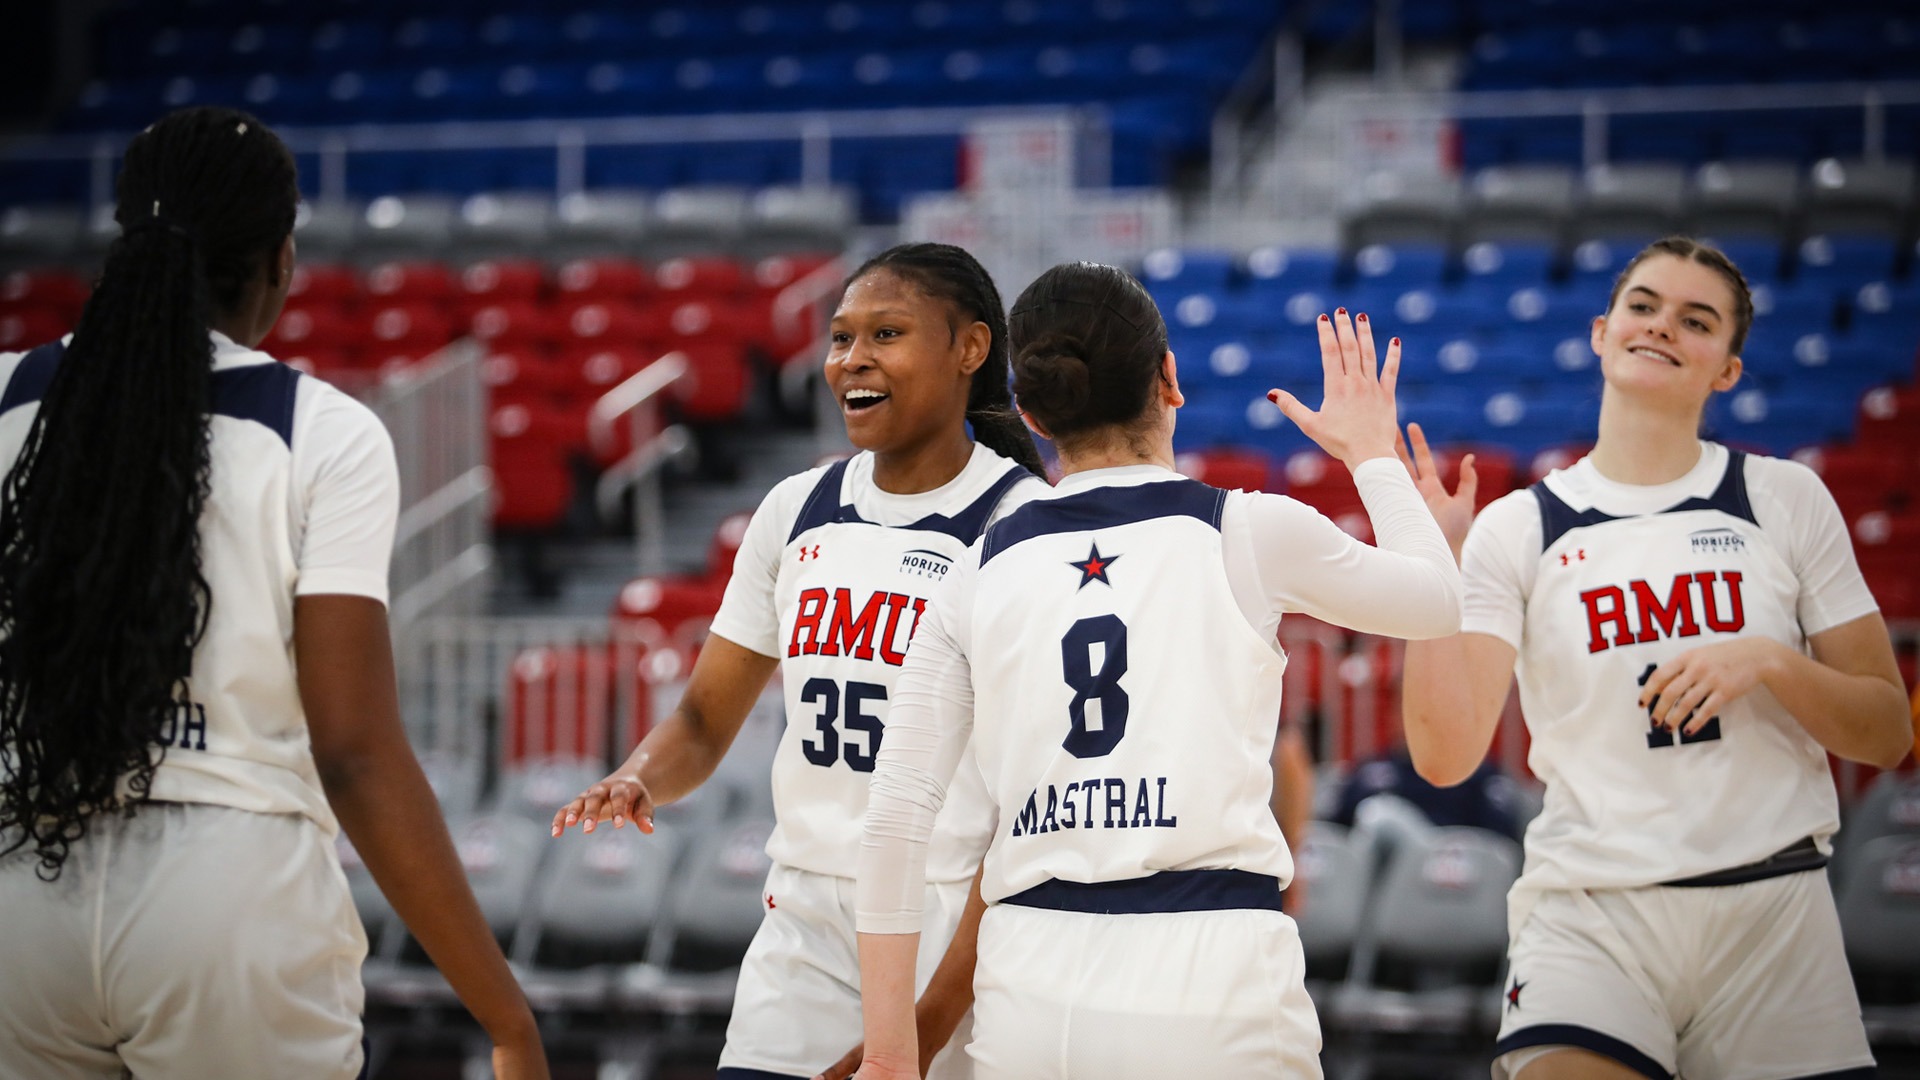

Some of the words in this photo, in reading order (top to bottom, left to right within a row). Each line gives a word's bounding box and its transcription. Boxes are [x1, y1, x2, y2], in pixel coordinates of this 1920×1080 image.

[902, 556, 949, 576] HORIZO
[788, 587, 928, 667] RMU
[1580, 571, 1745, 654] RMU
[801, 677, 889, 773] 35
[1061, 613, 1129, 759] 8
[1012, 777, 1177, 837] MASTRAL
